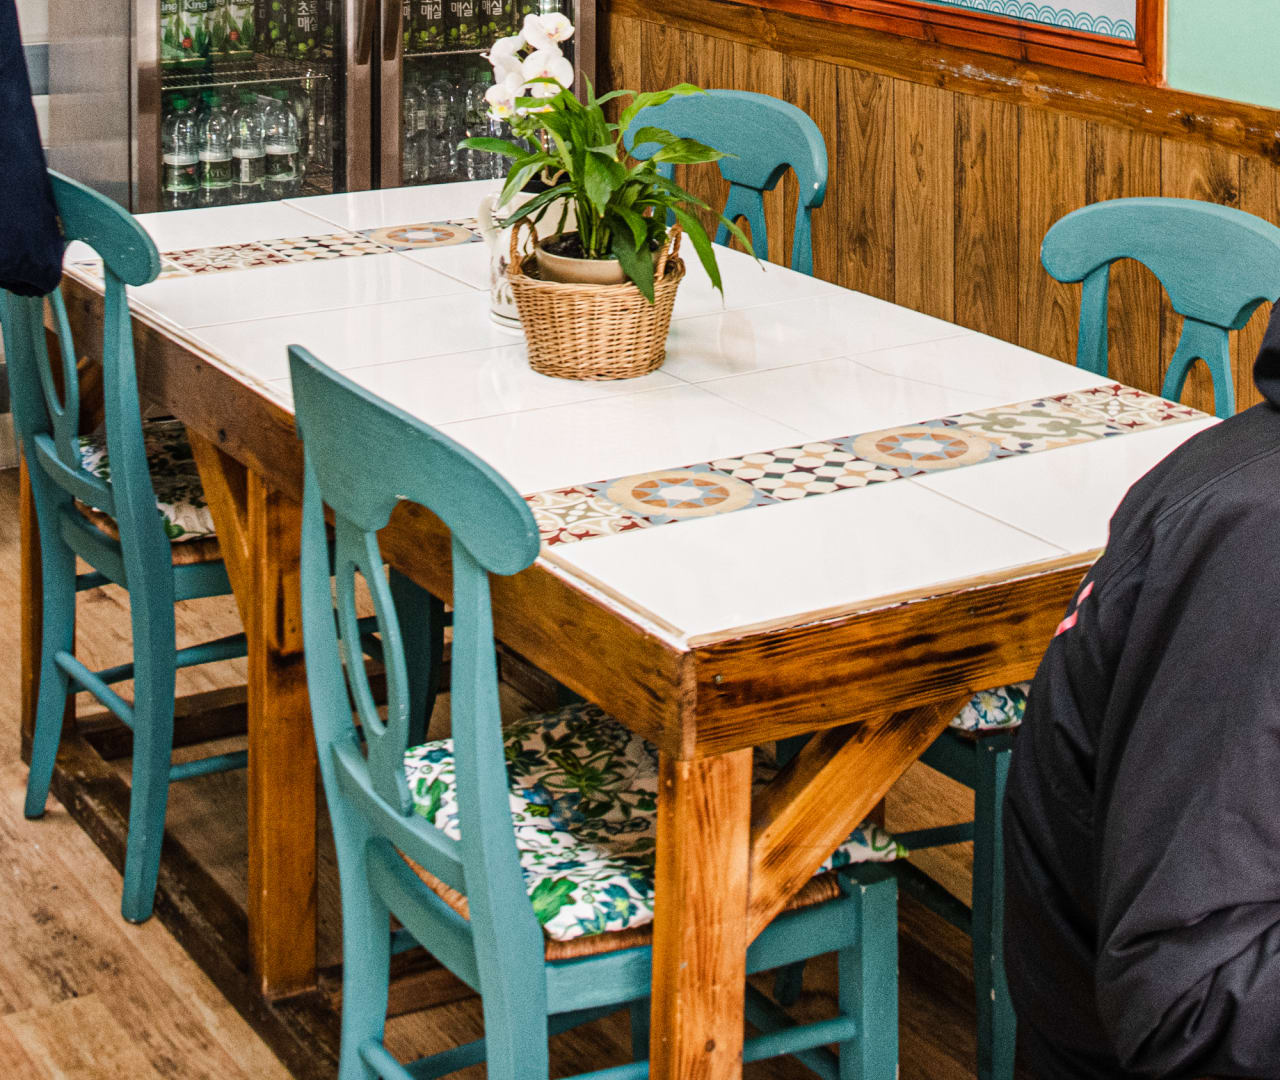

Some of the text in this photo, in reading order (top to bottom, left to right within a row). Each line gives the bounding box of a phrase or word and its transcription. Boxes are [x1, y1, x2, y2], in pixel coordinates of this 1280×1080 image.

[161, 1, 177, 12] ing
[184, 0, 208, 11] King
[297, 0, 318, 16] 초록
[421, 4, 442, 20] 매실
[451, 1, 473, 17] 매실
[482, 0, 503, 16] 매실
[297, 16, 319, 32] 매실
